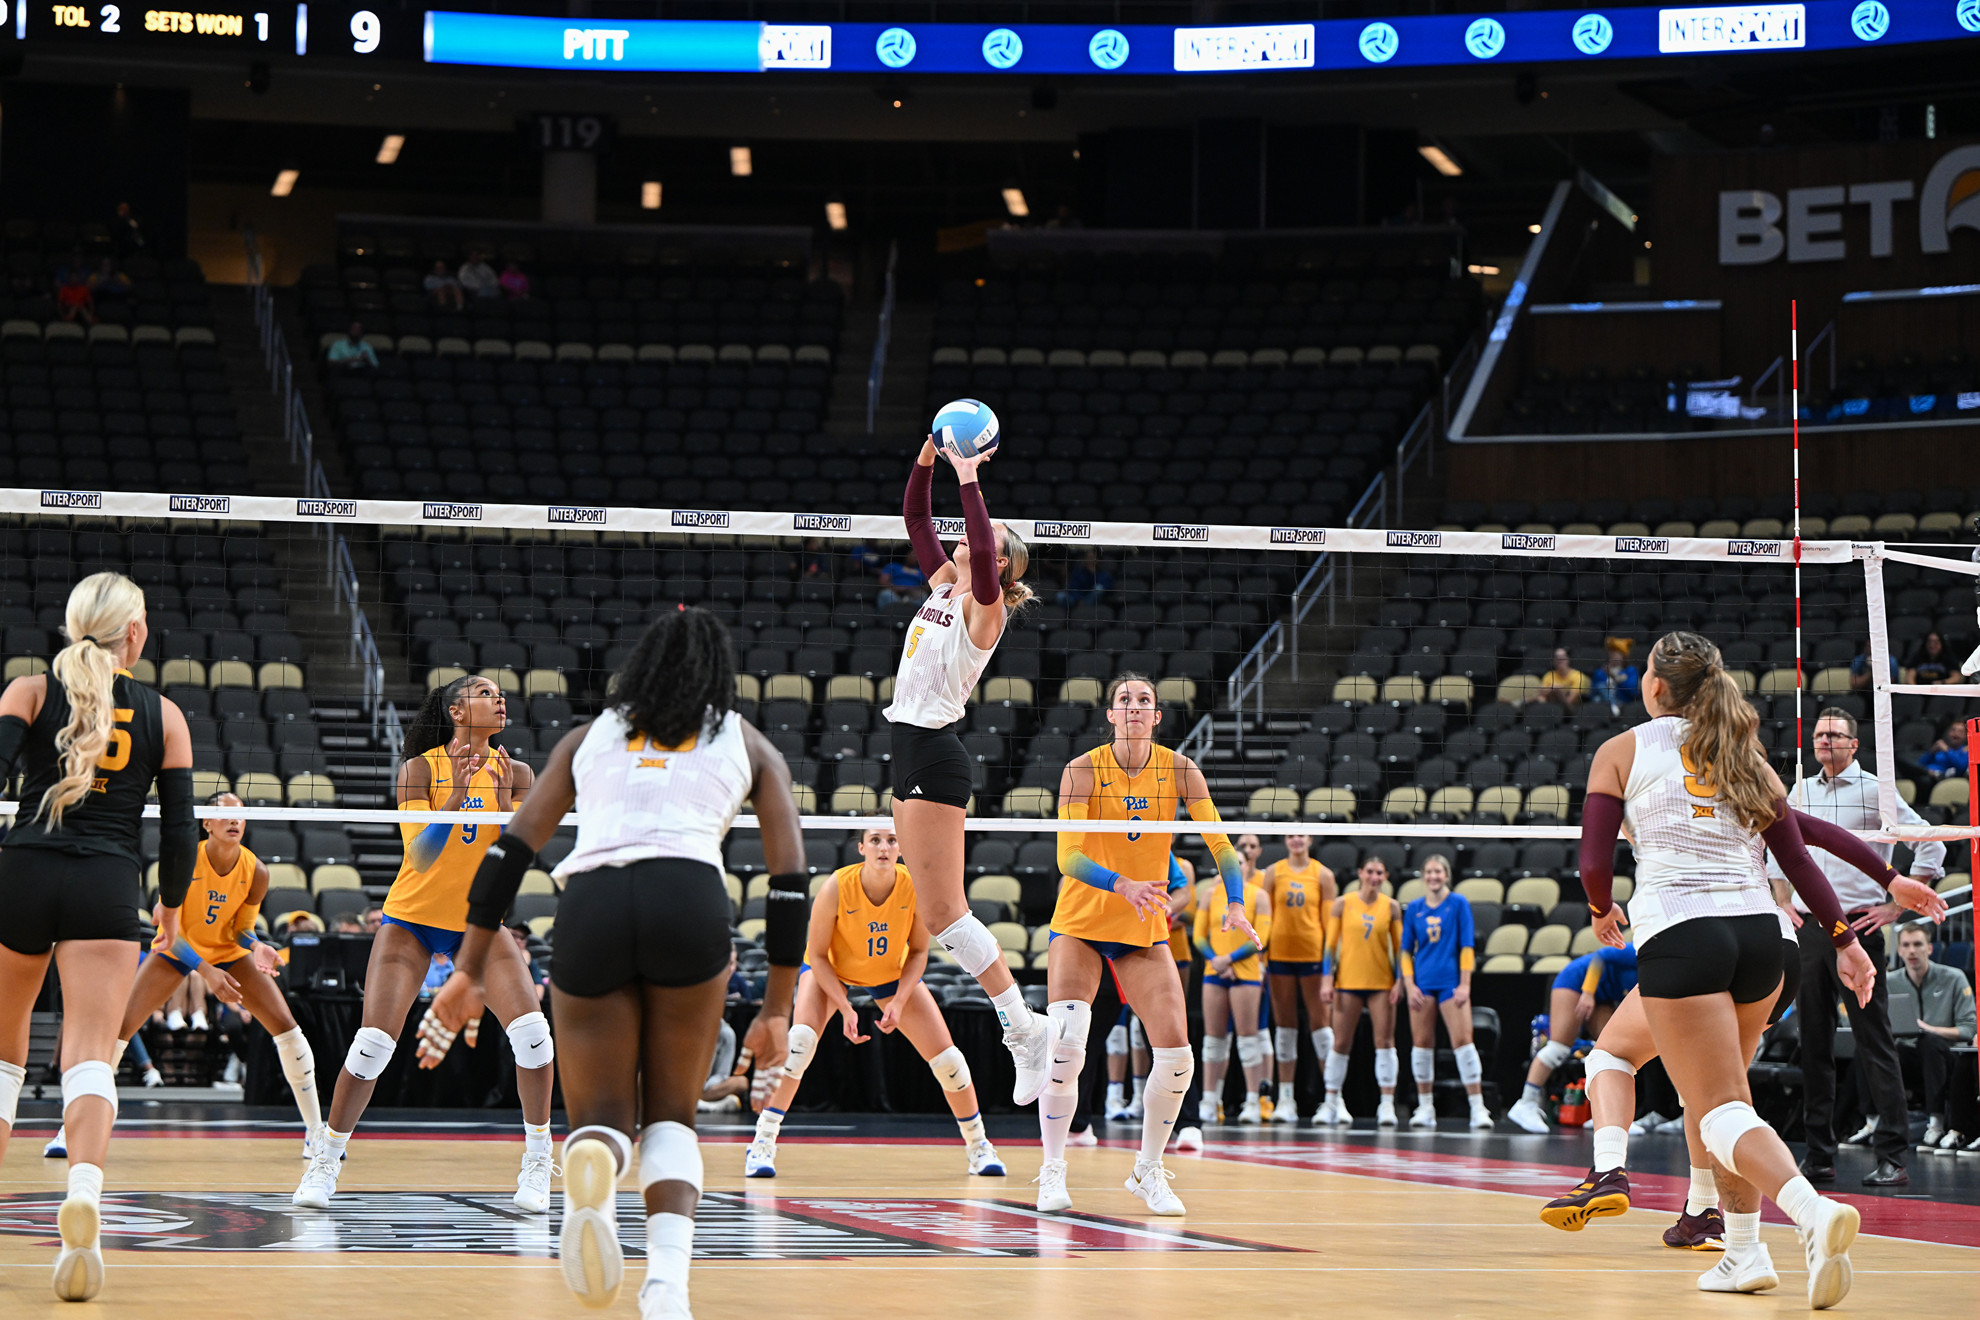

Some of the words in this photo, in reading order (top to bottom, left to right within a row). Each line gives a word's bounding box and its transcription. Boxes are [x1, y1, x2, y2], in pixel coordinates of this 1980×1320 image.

[52, 5, 90, 27] TOL
[100, 4, 120, 33] 2
[145, 10, 194, 34] SETS
[195, 13, 243, 36] WON
[254, 12, 269, 42] 1
[350, 10, 381, 54] 9
[563, 28, 629, 61] PITT
[538, 115, 601, 147] 119
[907, 625, 925, 659] 5
[1122, 796, 1149, 811] Pitt
[207, 890, 227, 903] Pitt
[1286, 891, 1305, 908] 20
[205, 904, 220, 925] 5
[867, 921, 889, 933] Pitt
[1364, 922, 1373, 940] 7
[867, 936, 888, 957] 19
